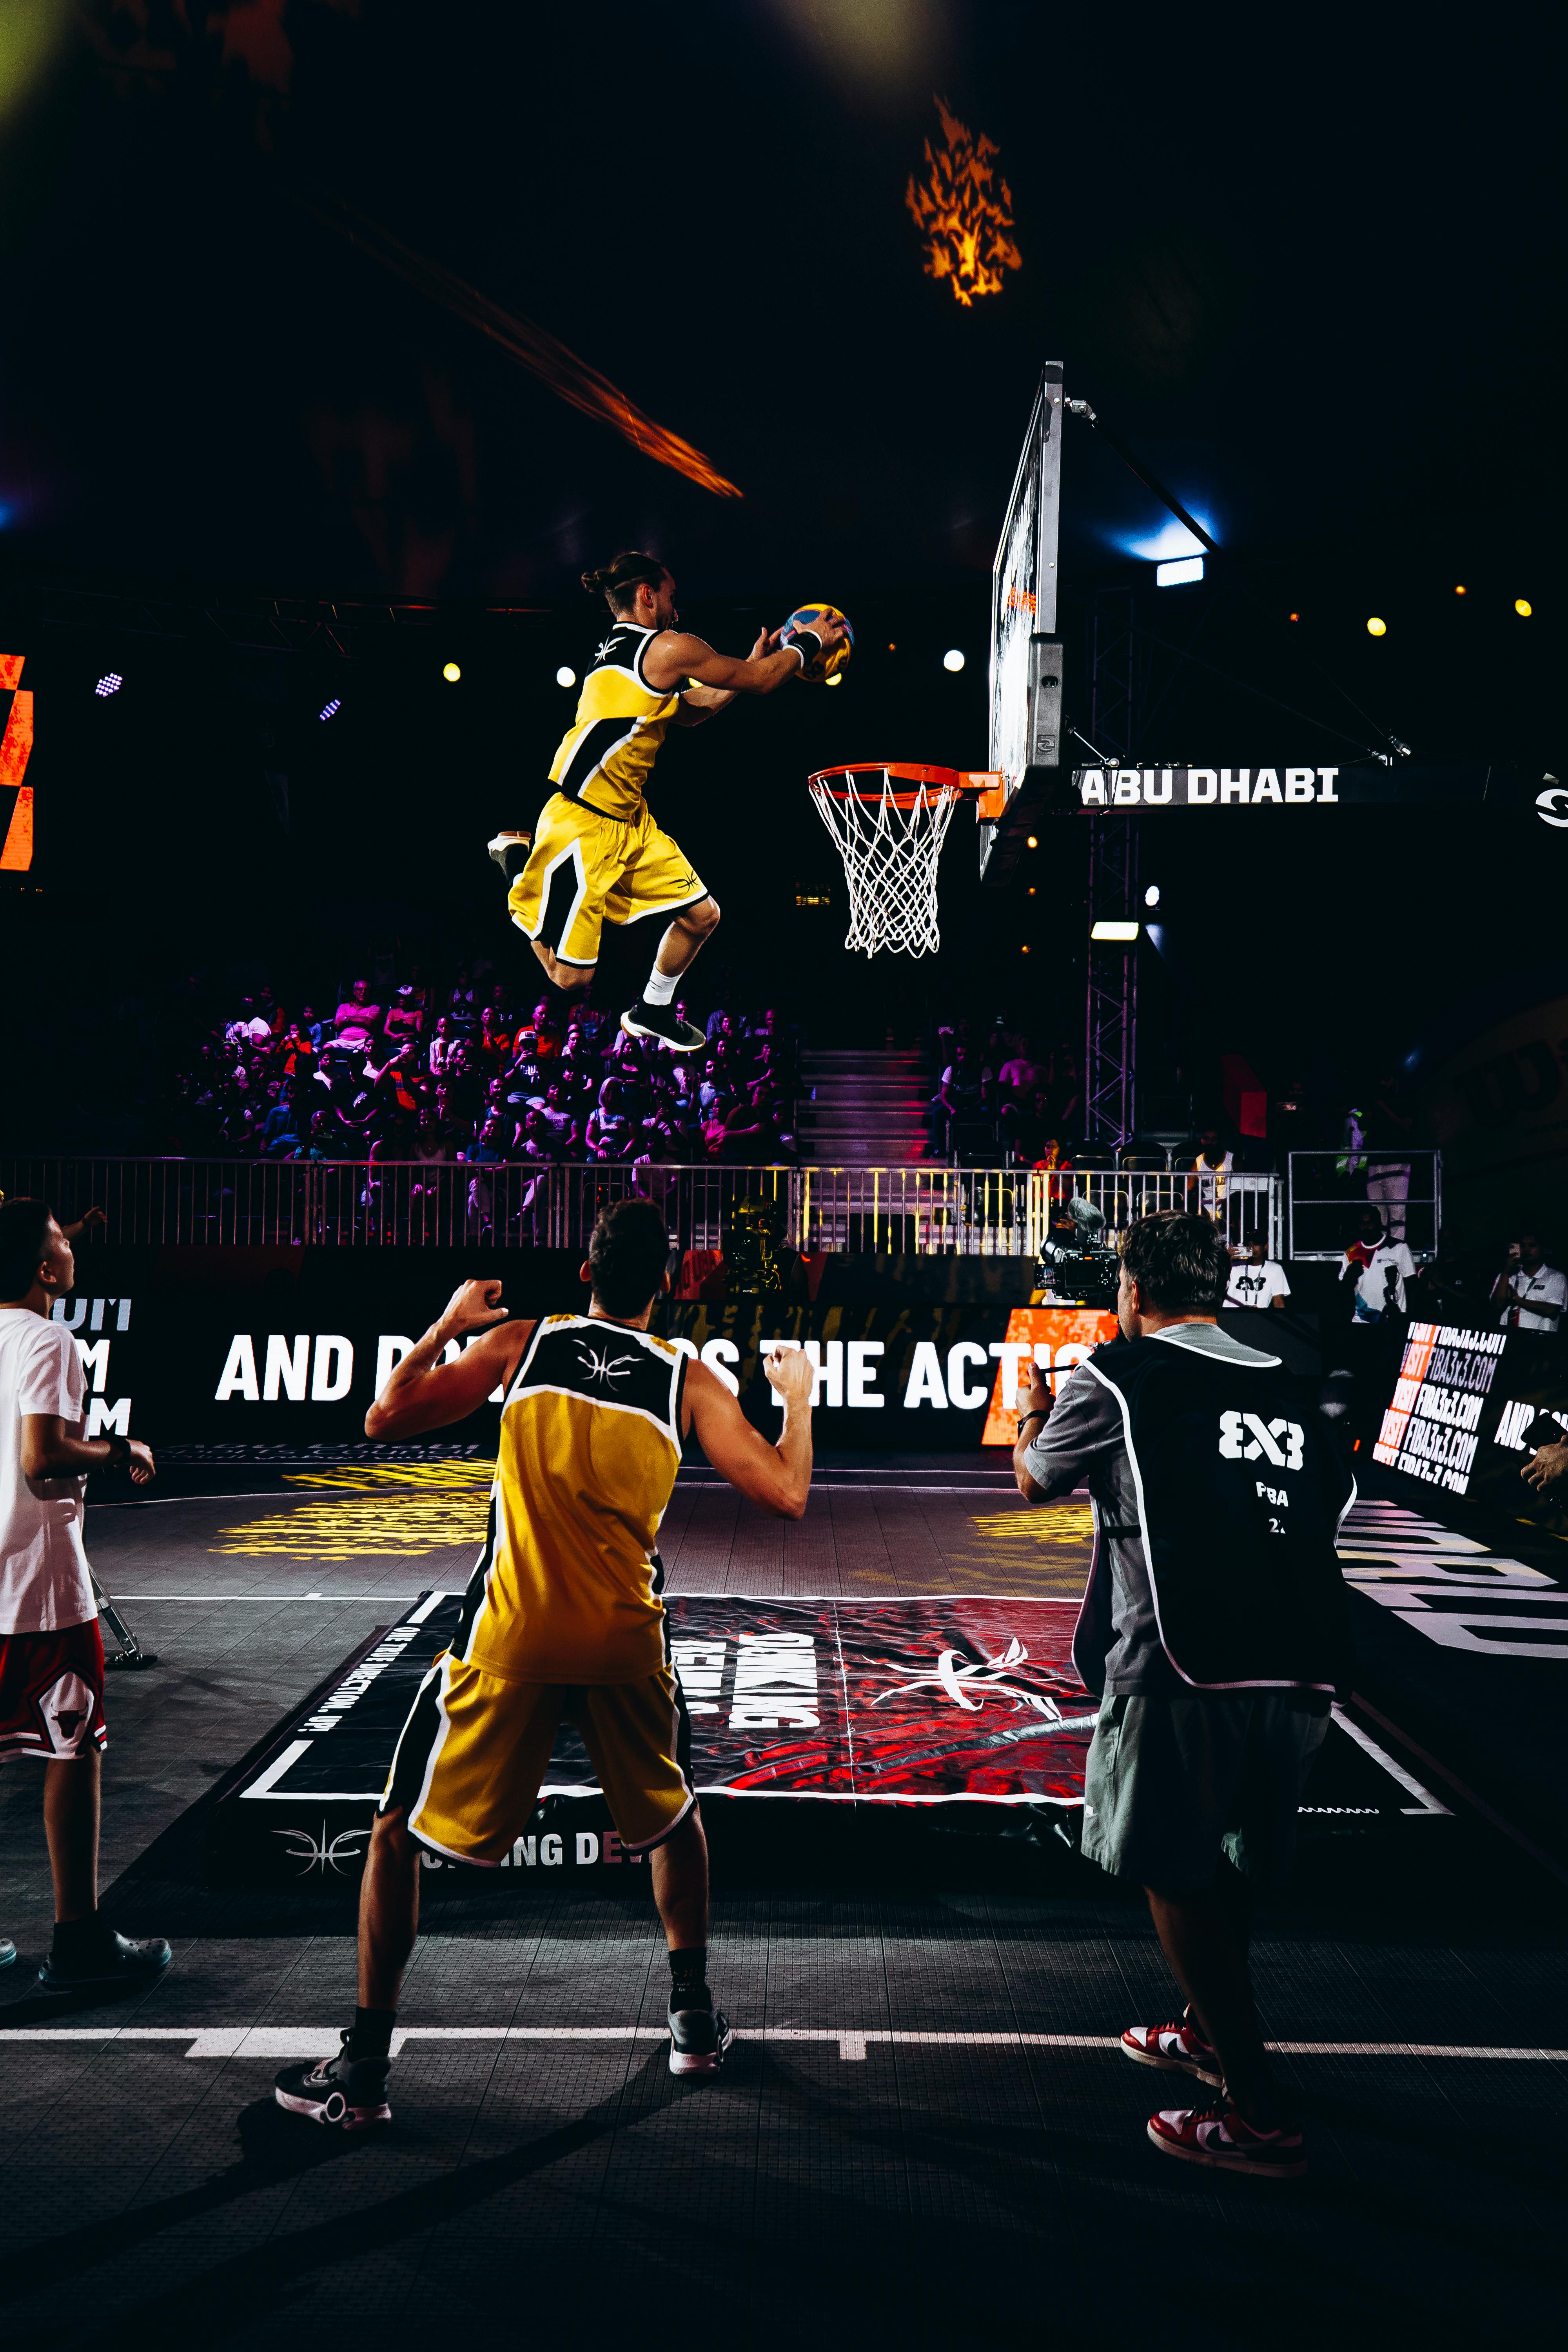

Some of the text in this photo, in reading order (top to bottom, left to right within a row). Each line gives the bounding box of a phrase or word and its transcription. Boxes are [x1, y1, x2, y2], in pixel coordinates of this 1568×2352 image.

[1082, 767, 1339, 805] ABU DHABI
[214, 1335, 354, 1401] AND
[1400, 1343, 1429, 1377] VISIT
[1392, 1377, 1421, 1413] VISIT
[1378, 1408, 1410, 1449] VISIT
[1494, 1400, 1535, 1451] AND
[365, 1643, 408, 1662] TRUE
[385, 1627, 421, 1642] ONE
[728, 1633, 820, 1729] DUNKING
[297, 1715, 343, 1732] UP!
